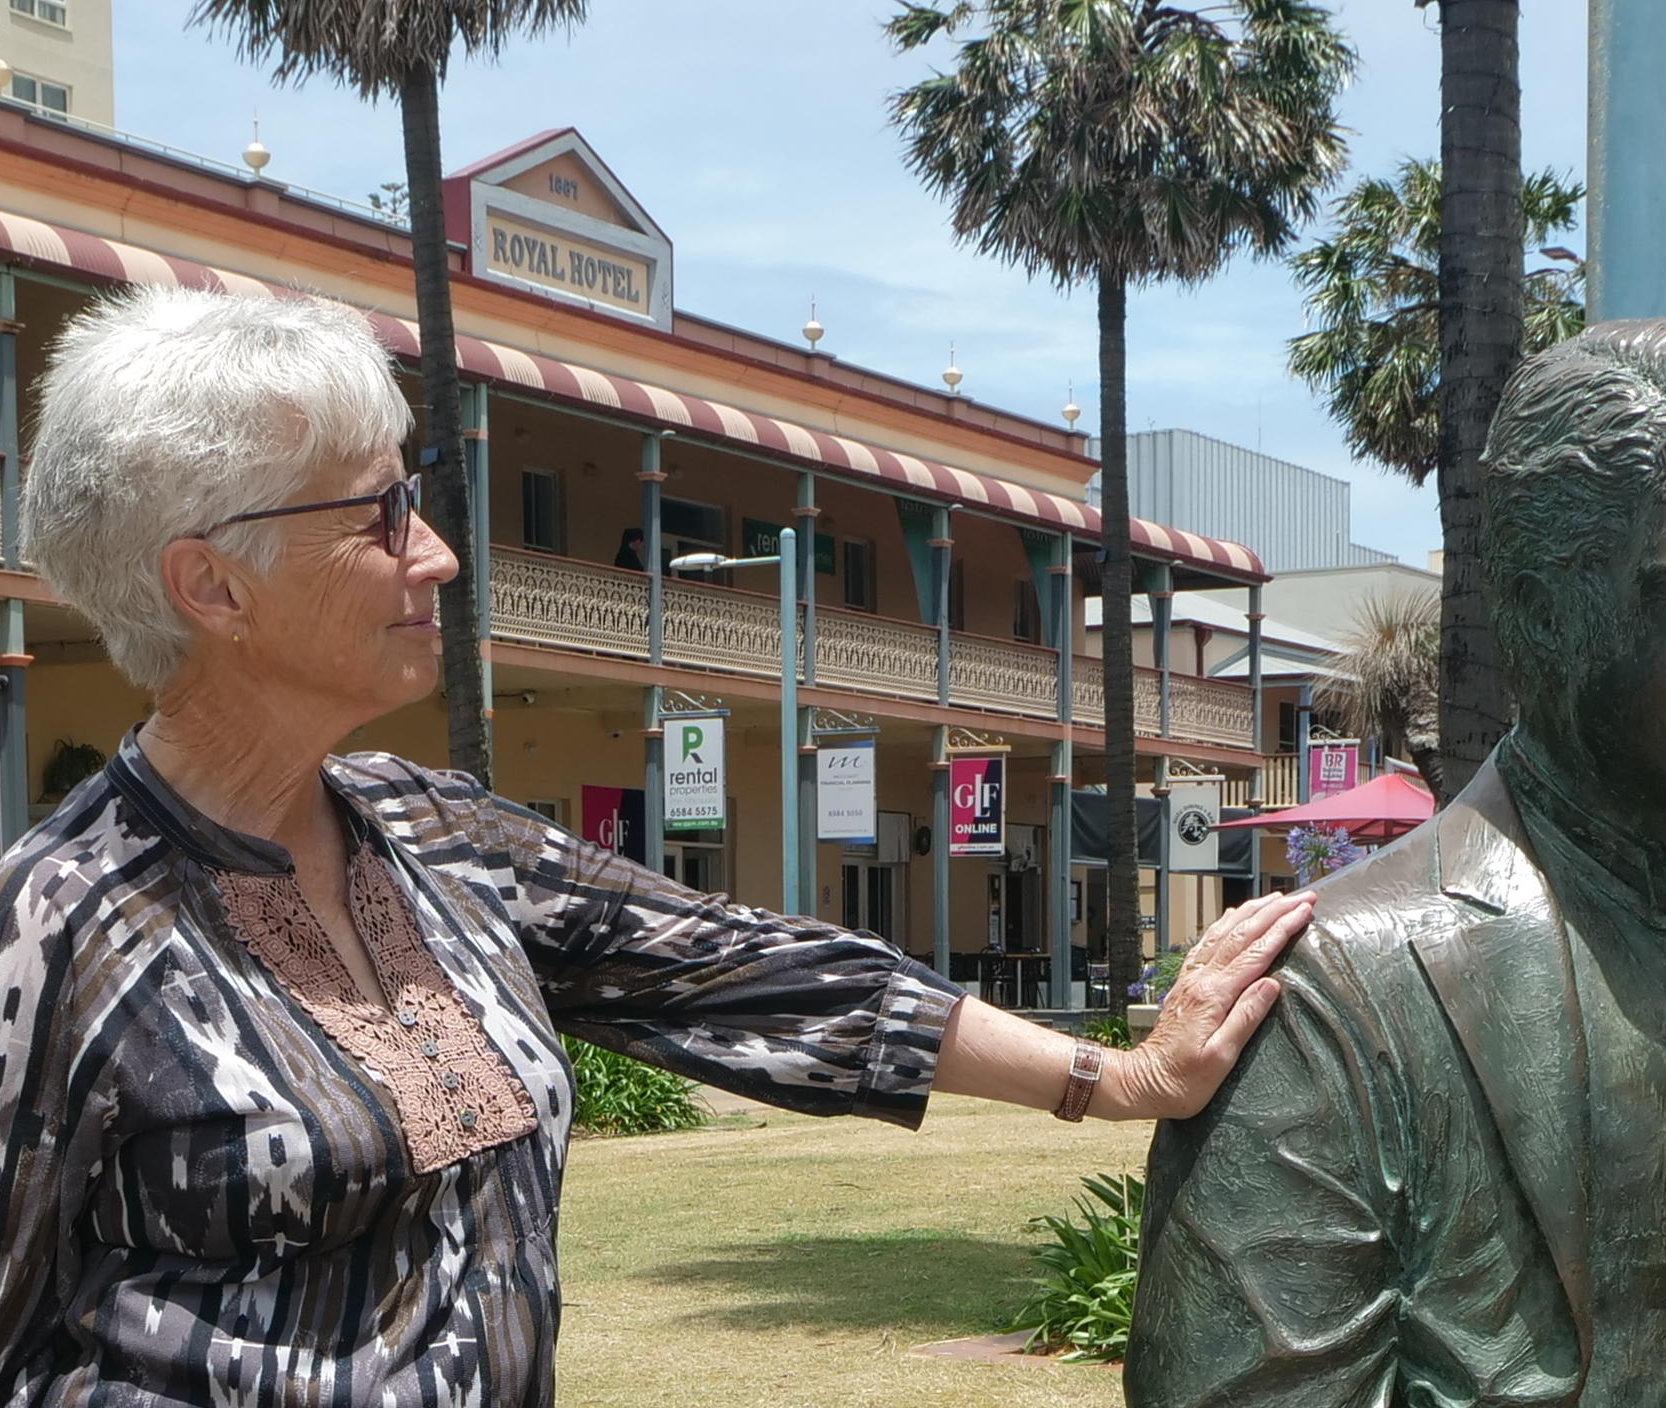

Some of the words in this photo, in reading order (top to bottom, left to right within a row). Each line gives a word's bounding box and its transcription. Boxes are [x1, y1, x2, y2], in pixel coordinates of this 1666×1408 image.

[549, 172, 578, 200] 1887
[492, 227, 565, 281] ROYAL
[569, 250, 639, 302] HOTEL
[1324, 753, 1343, 768] BR
[670, 767, 717, 785] rental
[669, 785, 717, 797] properties
[670, 807, 692, 817] 6584
[695, 806, 717, 816] 5575
[955, 823, 997, 834] ONLINE
